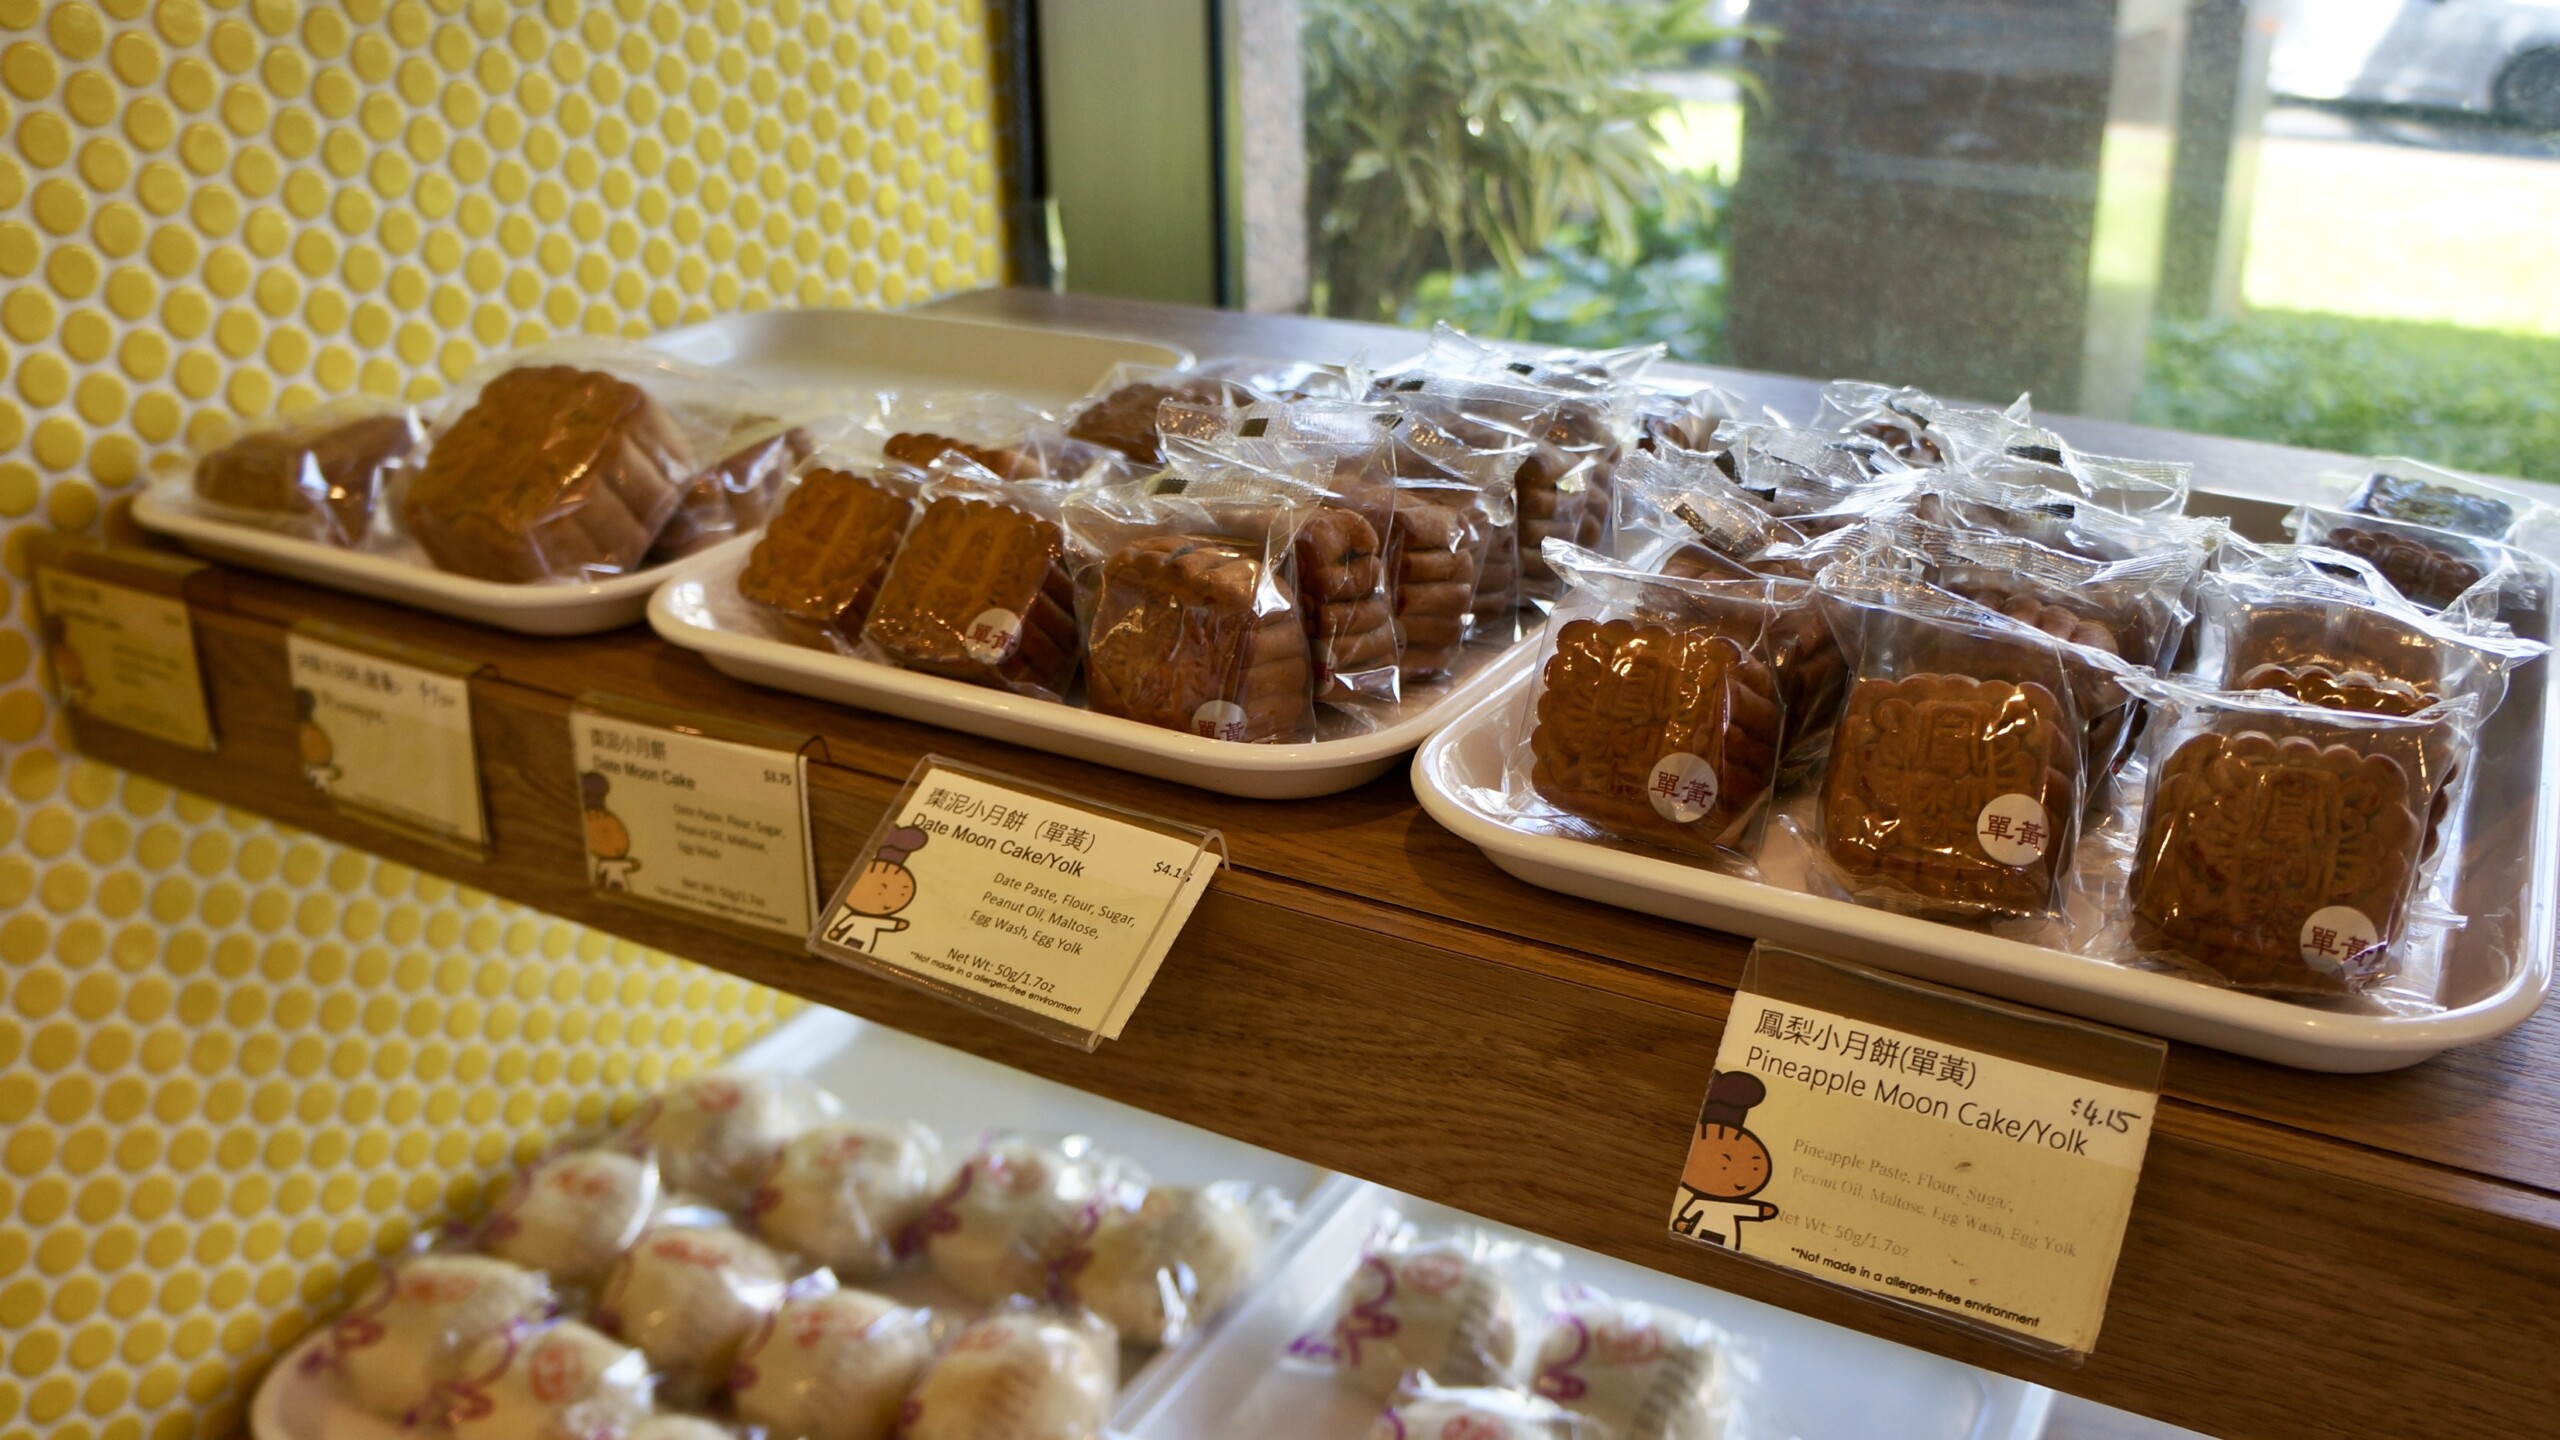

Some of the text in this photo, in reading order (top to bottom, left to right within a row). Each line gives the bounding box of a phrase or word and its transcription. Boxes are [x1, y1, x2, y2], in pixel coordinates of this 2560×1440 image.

[624, 761, 659, 782] Moon
[661, 769, 696, 791] Cake
[1650, 771, 1714, 808] 單黃
[910, 812, 1086, 878] Date Moon Cake/Yolk
[1980, 813, 2048, 851] 單黃
[981, 890, 1100, 940] Peanut Oil, Maltose,
[993, 872, 1136, 929] Date Paste, Flour, Sugar,
[969, 909, 1084, 956] Egg Wash, Egg Yolk
[930, 959, 955, 972] made
[956, 966, 965, 975] in
[973, 973, 1027, 997] allergen-free
[1027, 992, 1082, 1015] environment
[946, 948, 1056, 993] Net Wt: 50g/1.7oz
[1746, 1045, 2090, 1157] Pineapple Moon Cake/Yolk
[2070, 1097, 2142, 1134] $4.15
[1793, 1138, 1865, 1169] Pineapple
[1916, 1171, 1960, 1200] Flour,
[1966, 1186, 2014, 1214] Sugar,
[1792, 1166, 1838, 1191] Peanut
[1931, 1205, 1960, 1228] Egg
[2010, 1226, 2039, 1250] Egg
[2044, 1235, 2077, 1258] Yolk
[1804, 1216, 1831, 1236] Wt:
[1834, 1225, 1910, 1258] 50g/1.7oz
[1821, 1257, 1857, 1275] made
[1859, 1266, 1871, 1279] in
[1873, 1272, 1882, 1282] a
[1884, 1275, 1962, 1305] allergen-free
[1963, 1298, 2041, 1328] environment
